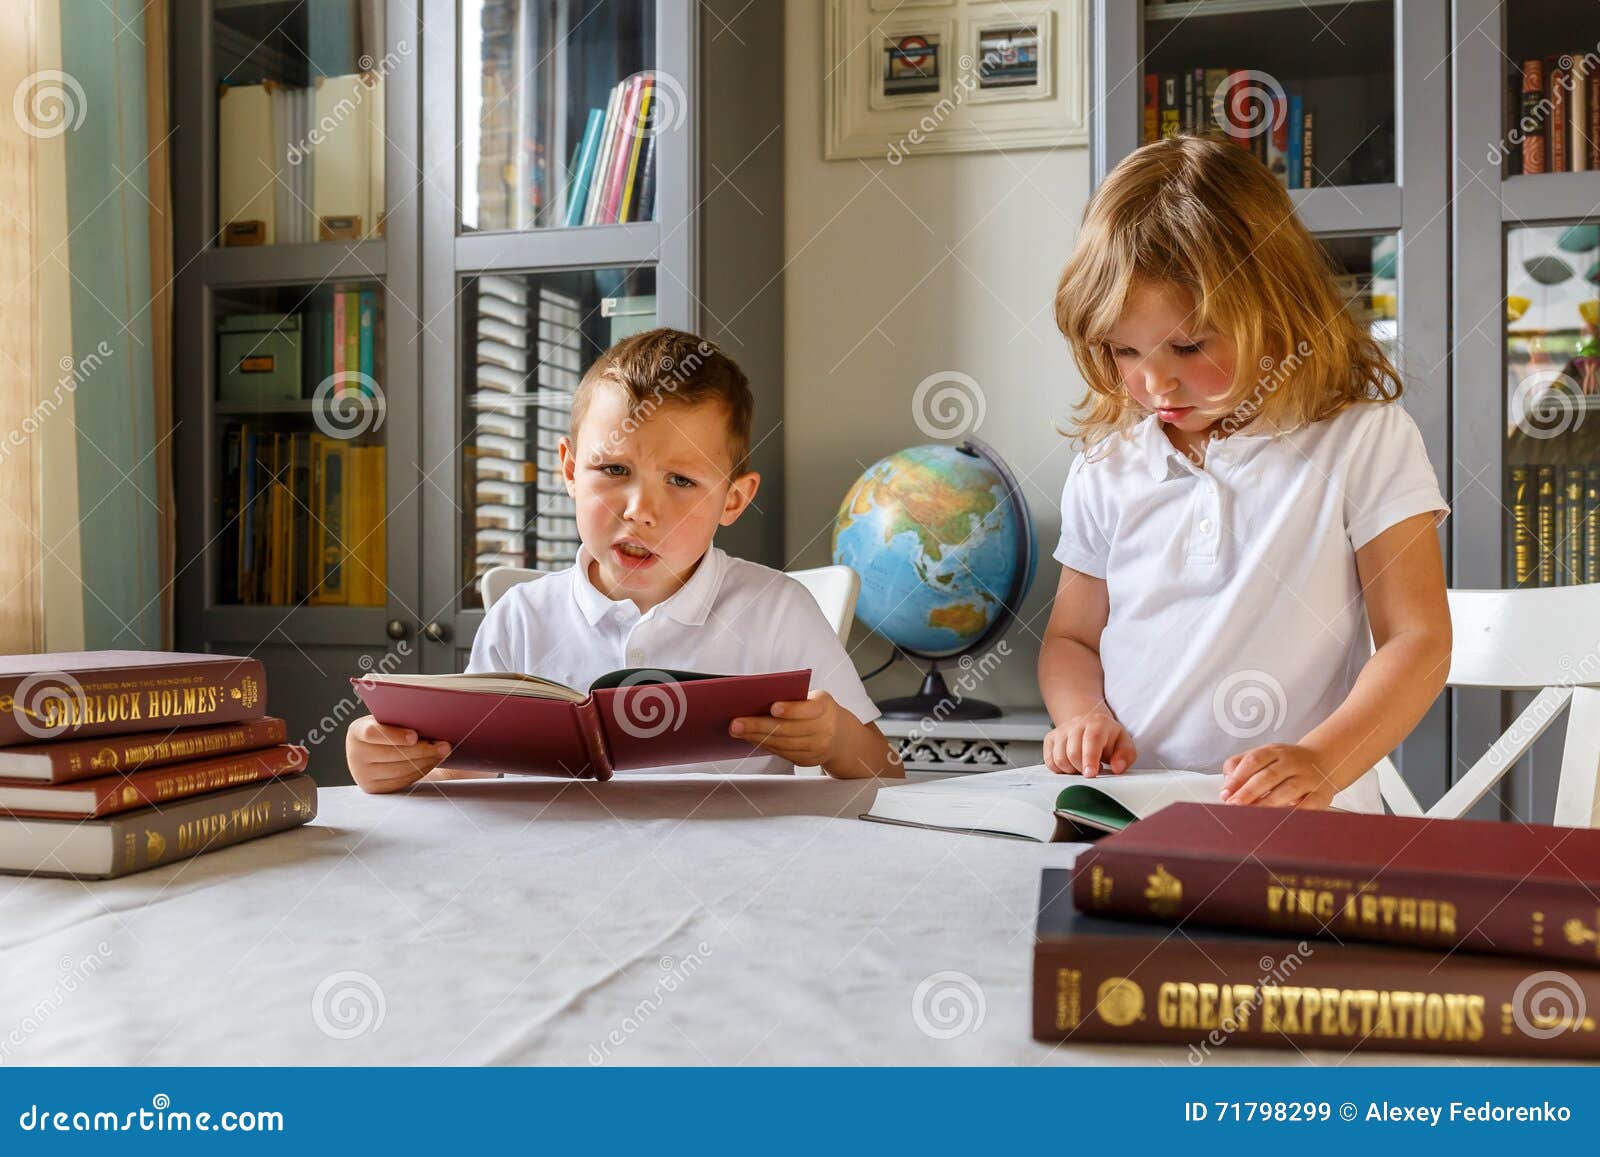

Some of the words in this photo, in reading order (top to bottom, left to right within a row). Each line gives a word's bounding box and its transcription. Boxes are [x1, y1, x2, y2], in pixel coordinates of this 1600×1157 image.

[45, 691, 142, 728] SHERLOCK
[149, 686, 217, 718] HOLMES
[178, 812, 226, 850] OLIVER
[231, 801, 271, 834] TWIST
[1267, 885, 1335, 917] KING
[1344, 893, 1457, 934] ARTHUR
[1157, 981, 1255, 1032] GREAT
[1260, 985, 1486, 1042] EXPECTATIONS
